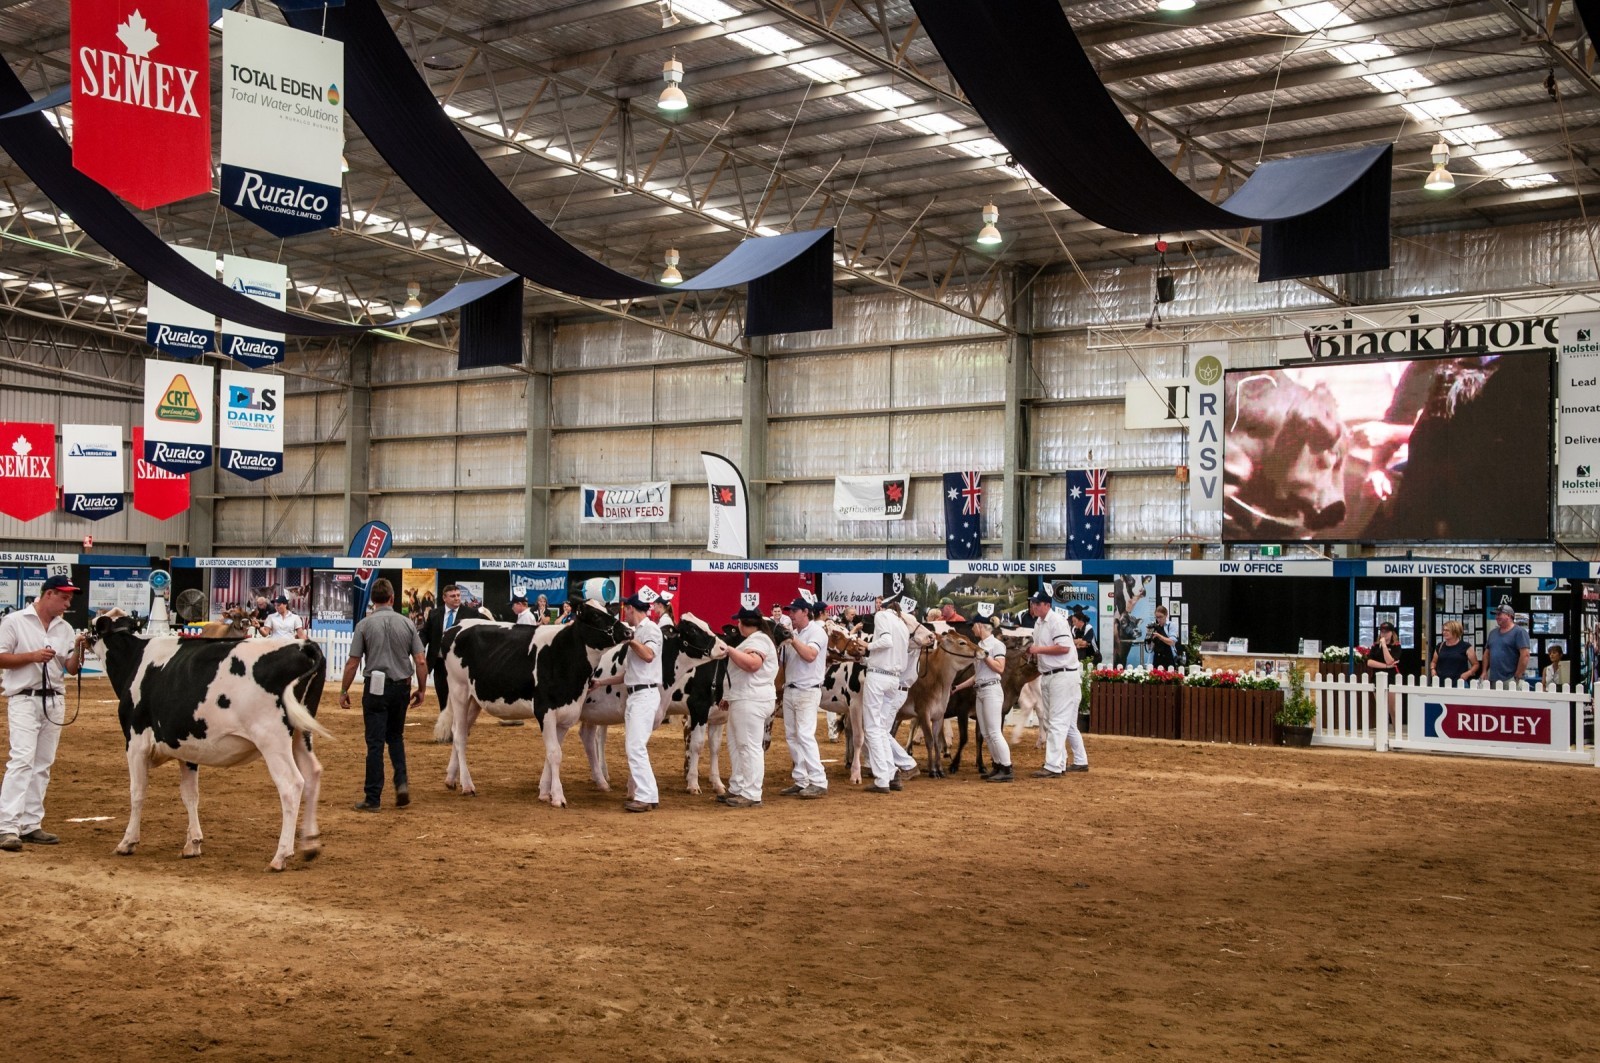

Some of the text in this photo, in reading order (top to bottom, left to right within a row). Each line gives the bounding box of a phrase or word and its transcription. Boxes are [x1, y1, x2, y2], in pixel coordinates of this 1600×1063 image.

[80, 46, 200, 118] SEMEX
[231, 64, 322, 102] TOTAL EDEN
[231, 88, 338, 124] Total Water Solutions
[234, 172, 328, 213] Ruralco
[262, 204, 322, 221] HOLDINGS LIMITED
[156, 324, 208, 346] Ruralco
[229, 336, 278, 358] Ruralco
[1563, 342, 1600, 354] Holstei
[1571, 377, 1596, 386] Lead
[167, 390, 189, 406] CRT
[228, 386, 276, 411] DLS
[228, 411, 274, 423] DAIRY
[1562, 404, 1600, 414] Innovat
[152, 442, 205, 462] Ruralco
[228, 450, 276, 470] Ruralco
[138, 458, 186, 480] SEM
[72, 494, 118, 510] Ruralco
[840, 504, 884, 514] agribusiness
[887, 504, 902, 512] nab
[606, 506, 664, 518] DAIRY FEEDS
[52, 566, 68, 574] 135
[726, 562, 778, 570] AGRIBUSINESS
[1002, 563, 1026, 571] WIDE
[1030, 564, 1056, 572] SIRES
[1220, 564, 1283, 573] IDW OFFICE
[1384, 564, 1532, 574] DAIRY LIVESTOCK SERVICES
[512, 574, 566, 590] LEGENDAIRY
[643, 588, 656, 599] 245
[826, 591, 848, 602] We're
[1458, 712, 1542, 736] RIDLEY
